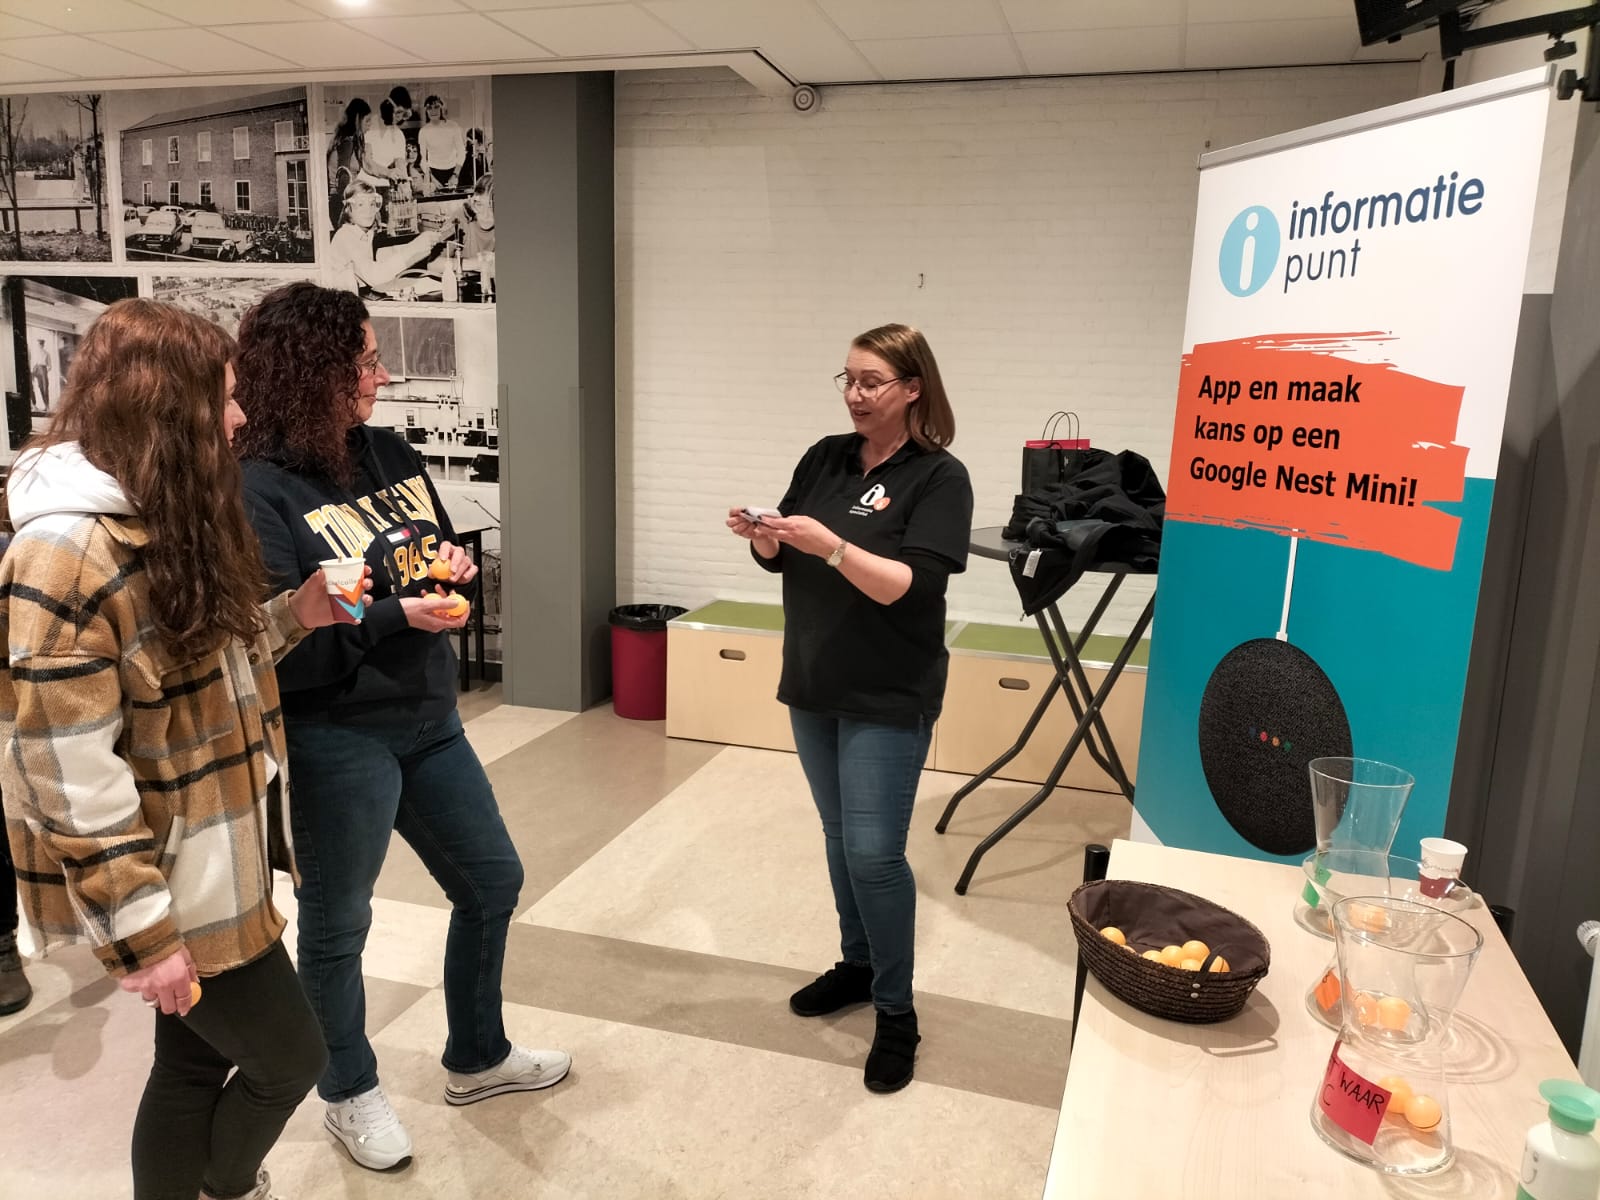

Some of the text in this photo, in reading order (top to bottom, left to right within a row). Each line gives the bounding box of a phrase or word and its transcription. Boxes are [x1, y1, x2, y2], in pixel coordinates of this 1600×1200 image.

[1289, 171, 1485, 240] informatie
[1284, 238, 1361, 293] punt
[1198, 374, 1362, 405] App en maak
[1194, 415, 1340, 451] kans op een
[1190, 457, 1418, 507] Google Nest Mini!
